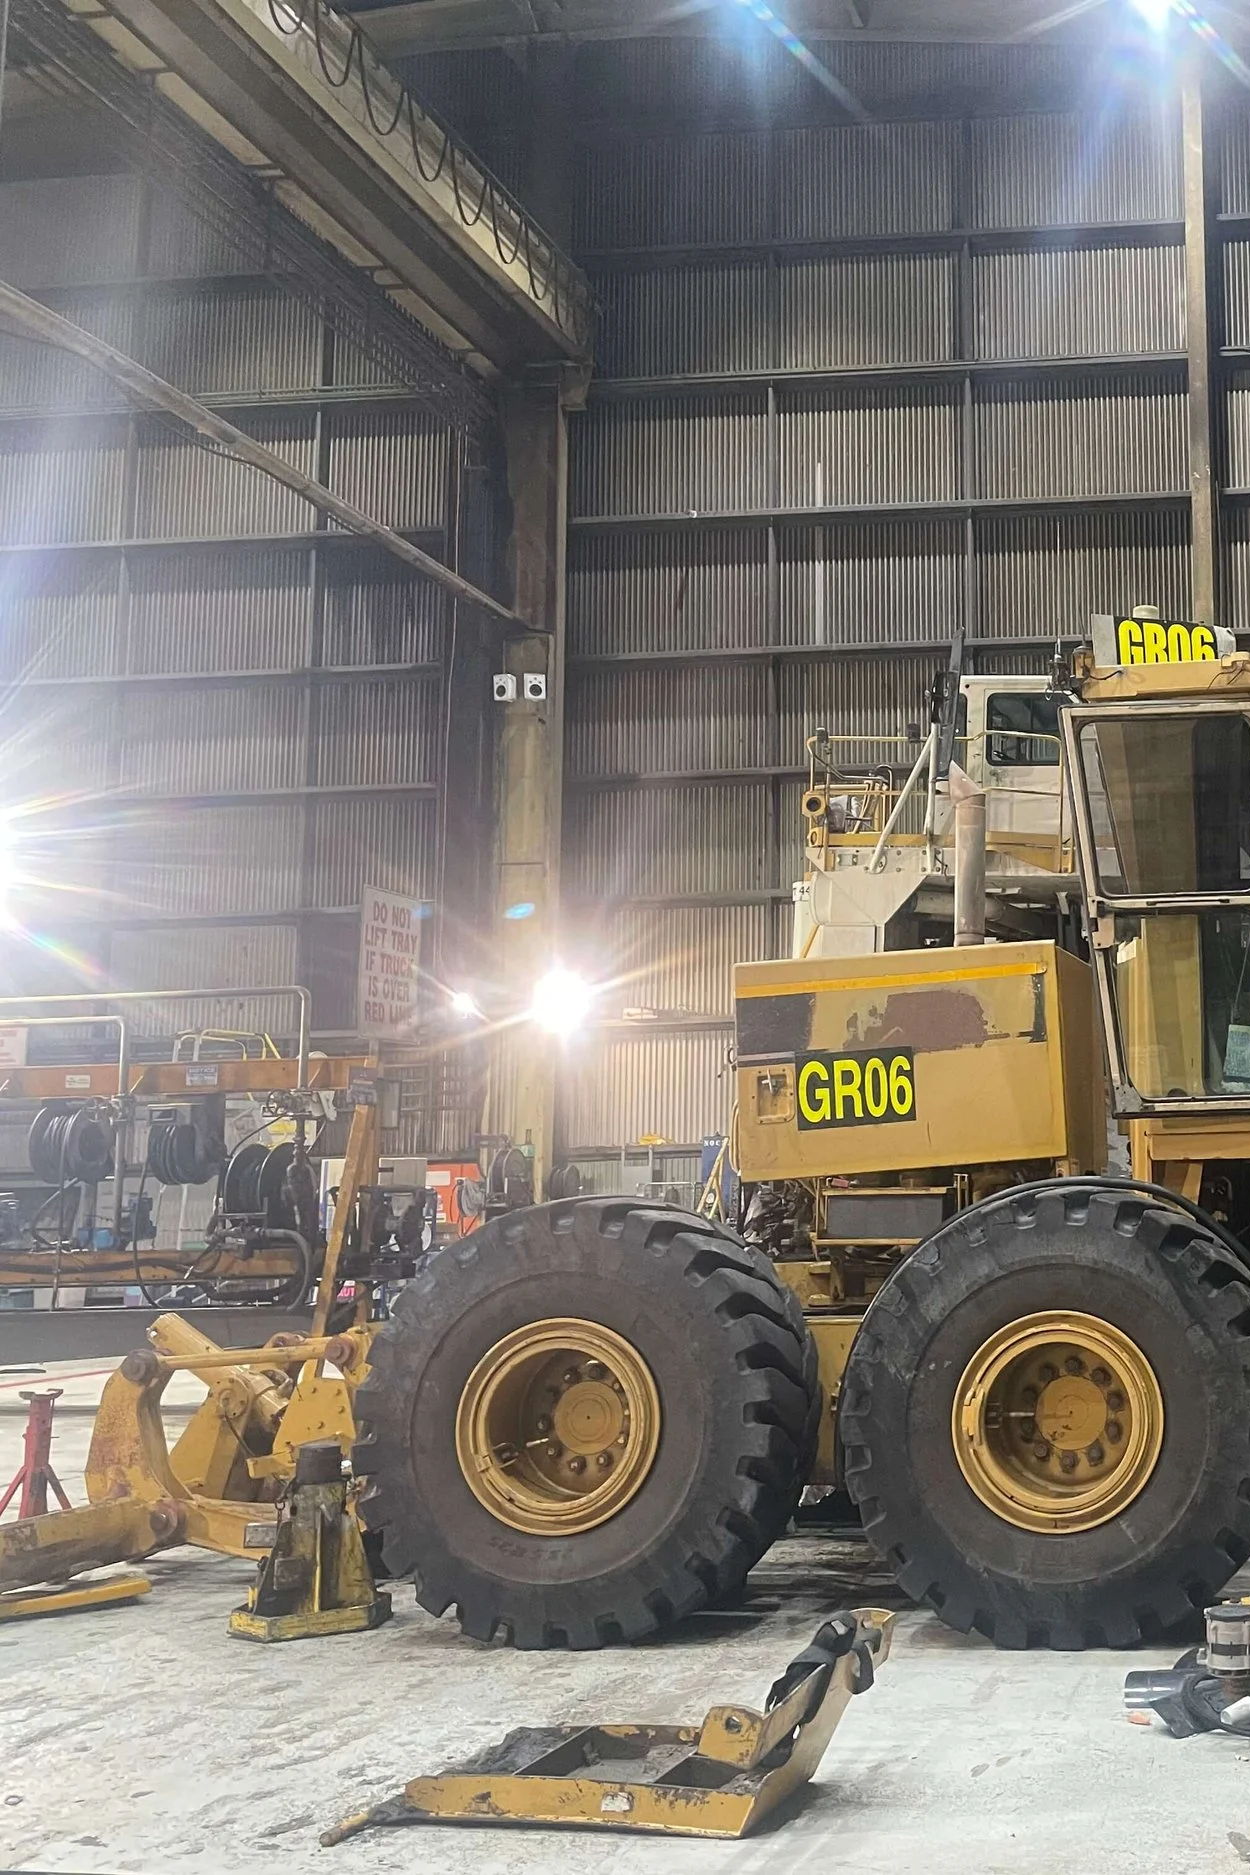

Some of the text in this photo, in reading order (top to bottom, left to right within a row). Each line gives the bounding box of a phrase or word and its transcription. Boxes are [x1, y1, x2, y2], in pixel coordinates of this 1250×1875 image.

[1118, 619, 1216, 666] GR06
[373, 901, 412, 929] DO NOT
[364, 924, 417, 955] LIFT TRAY
[365, 950, 414, 979] IF TRUCK
[368, 975, 410, 1002] IS OVER
[364, 1001, 385, 1023] RED
[798, 1055, 913, 1123] GR06
